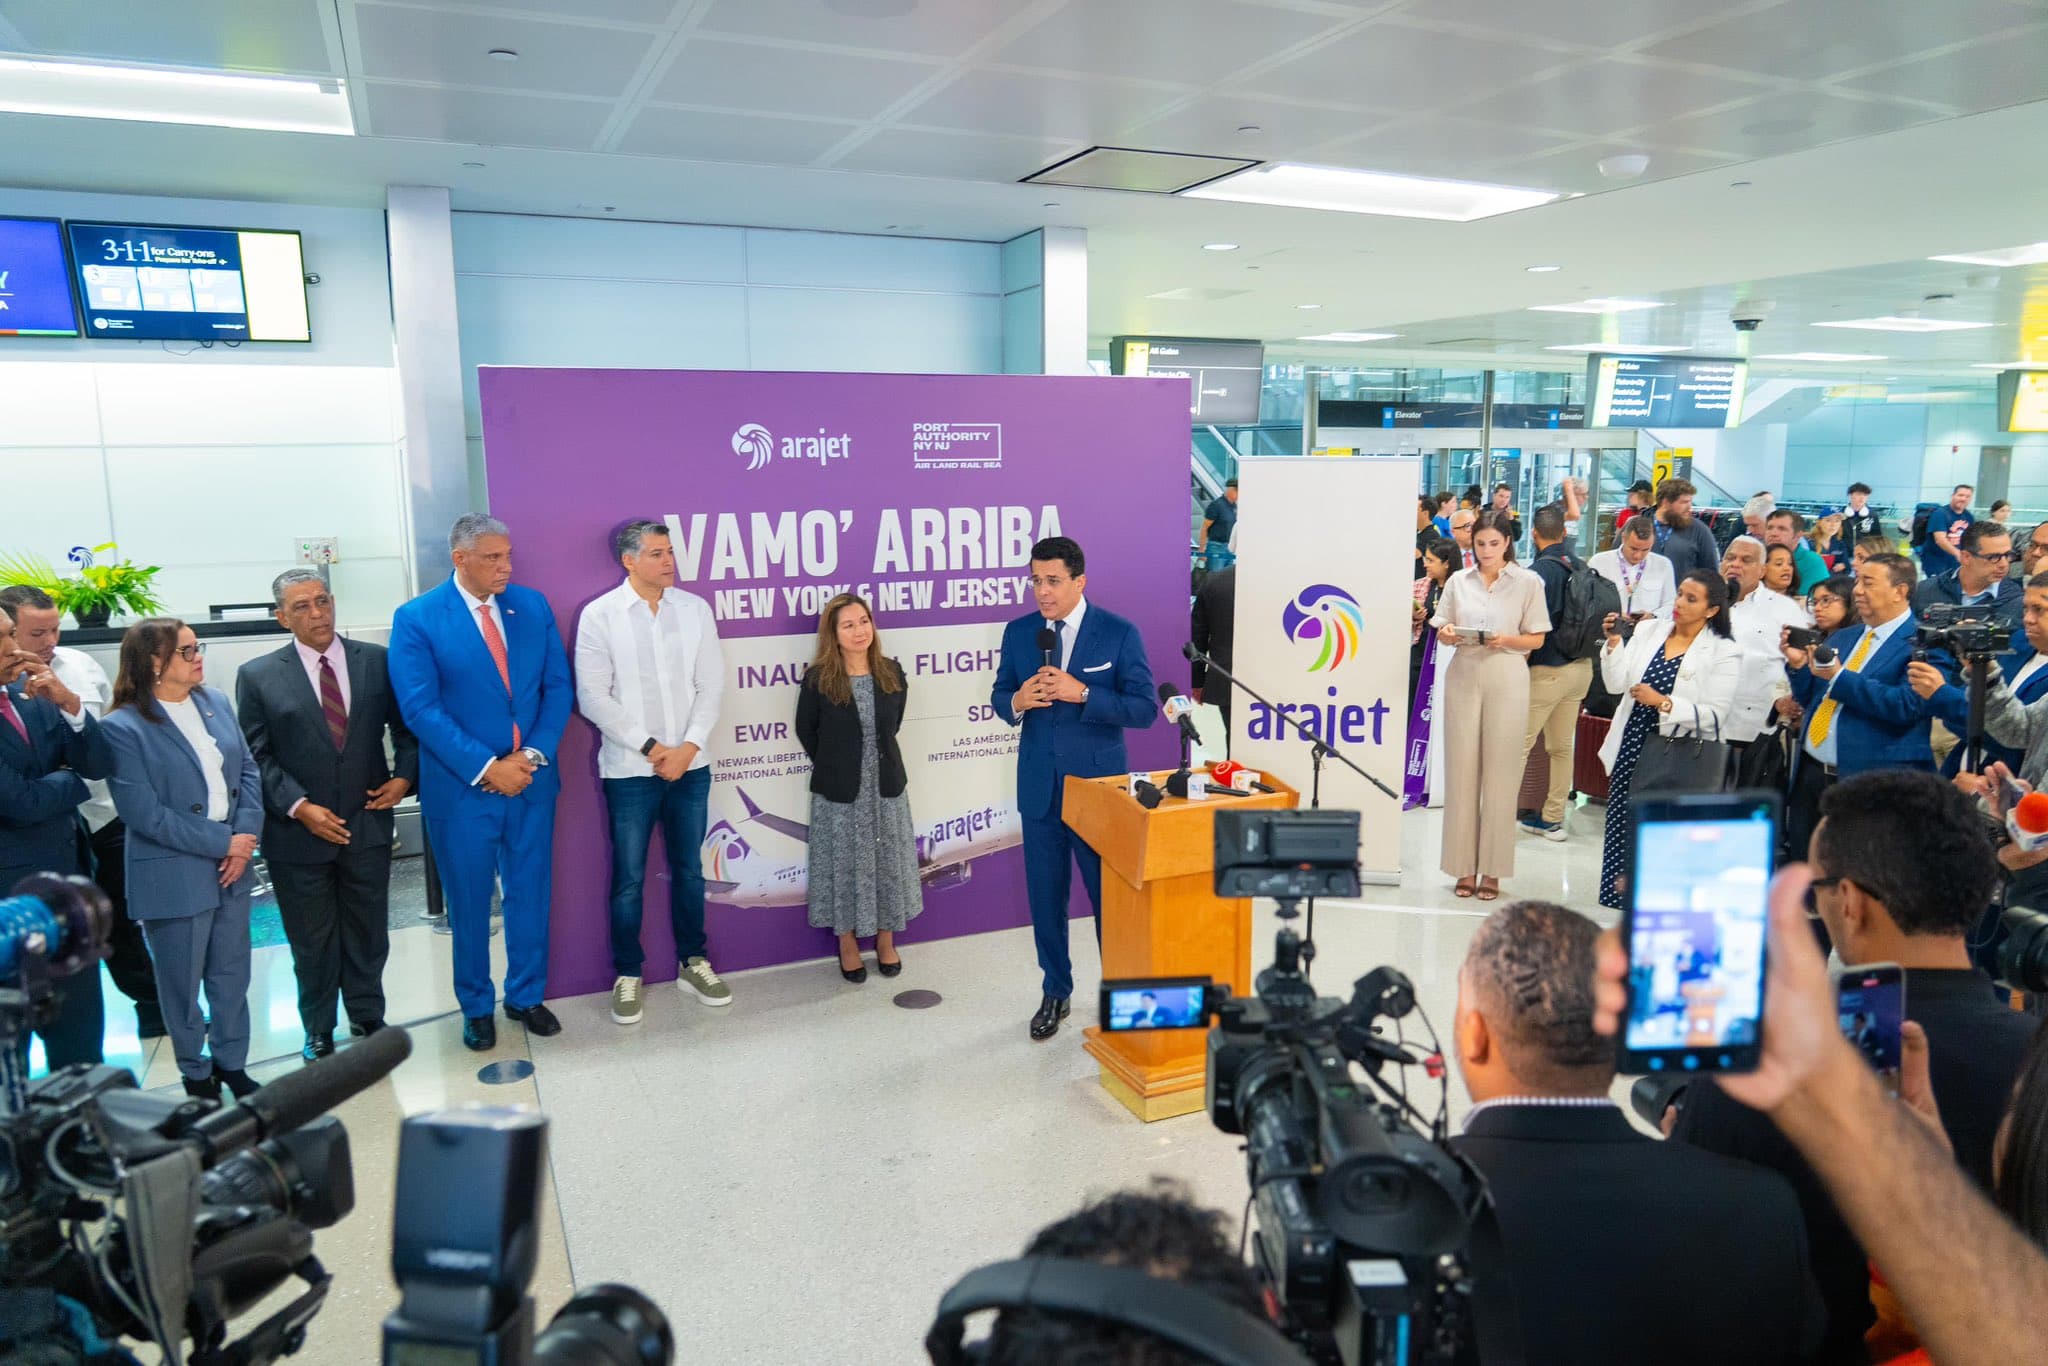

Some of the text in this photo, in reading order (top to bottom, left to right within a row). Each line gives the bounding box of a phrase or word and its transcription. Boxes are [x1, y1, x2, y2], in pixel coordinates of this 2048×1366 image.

[151, 247, 165, 256] for
[167, 247, 215, 259] Carry-ons
[1395, 411, 1422, 419] Elevator
[1559, 412, 1584, 420] Elevator
[913, 423, 950, 432] PORT
[913, 432, 990, 441] AUTHORITY
[781, 428, 851, 466] arajet
[913, 441, 950, 450] NY NJ
[714, 587, 775, 621] NEW
[878, 580, 934, 612] NEW
[968, 704, 995, 722] SD
[1247, 686, 1390, 758] arajet
[735, 722, 788, 743] EWR
[953, 737, 971, 747] LAS
[717, 754, 765, 768] NEWARK
[928, 747, 1005, 762] INTERNATIONAL
[711, 767, 783, 783] ERNATIONAL
[934, 807, 992, 842] arajet
